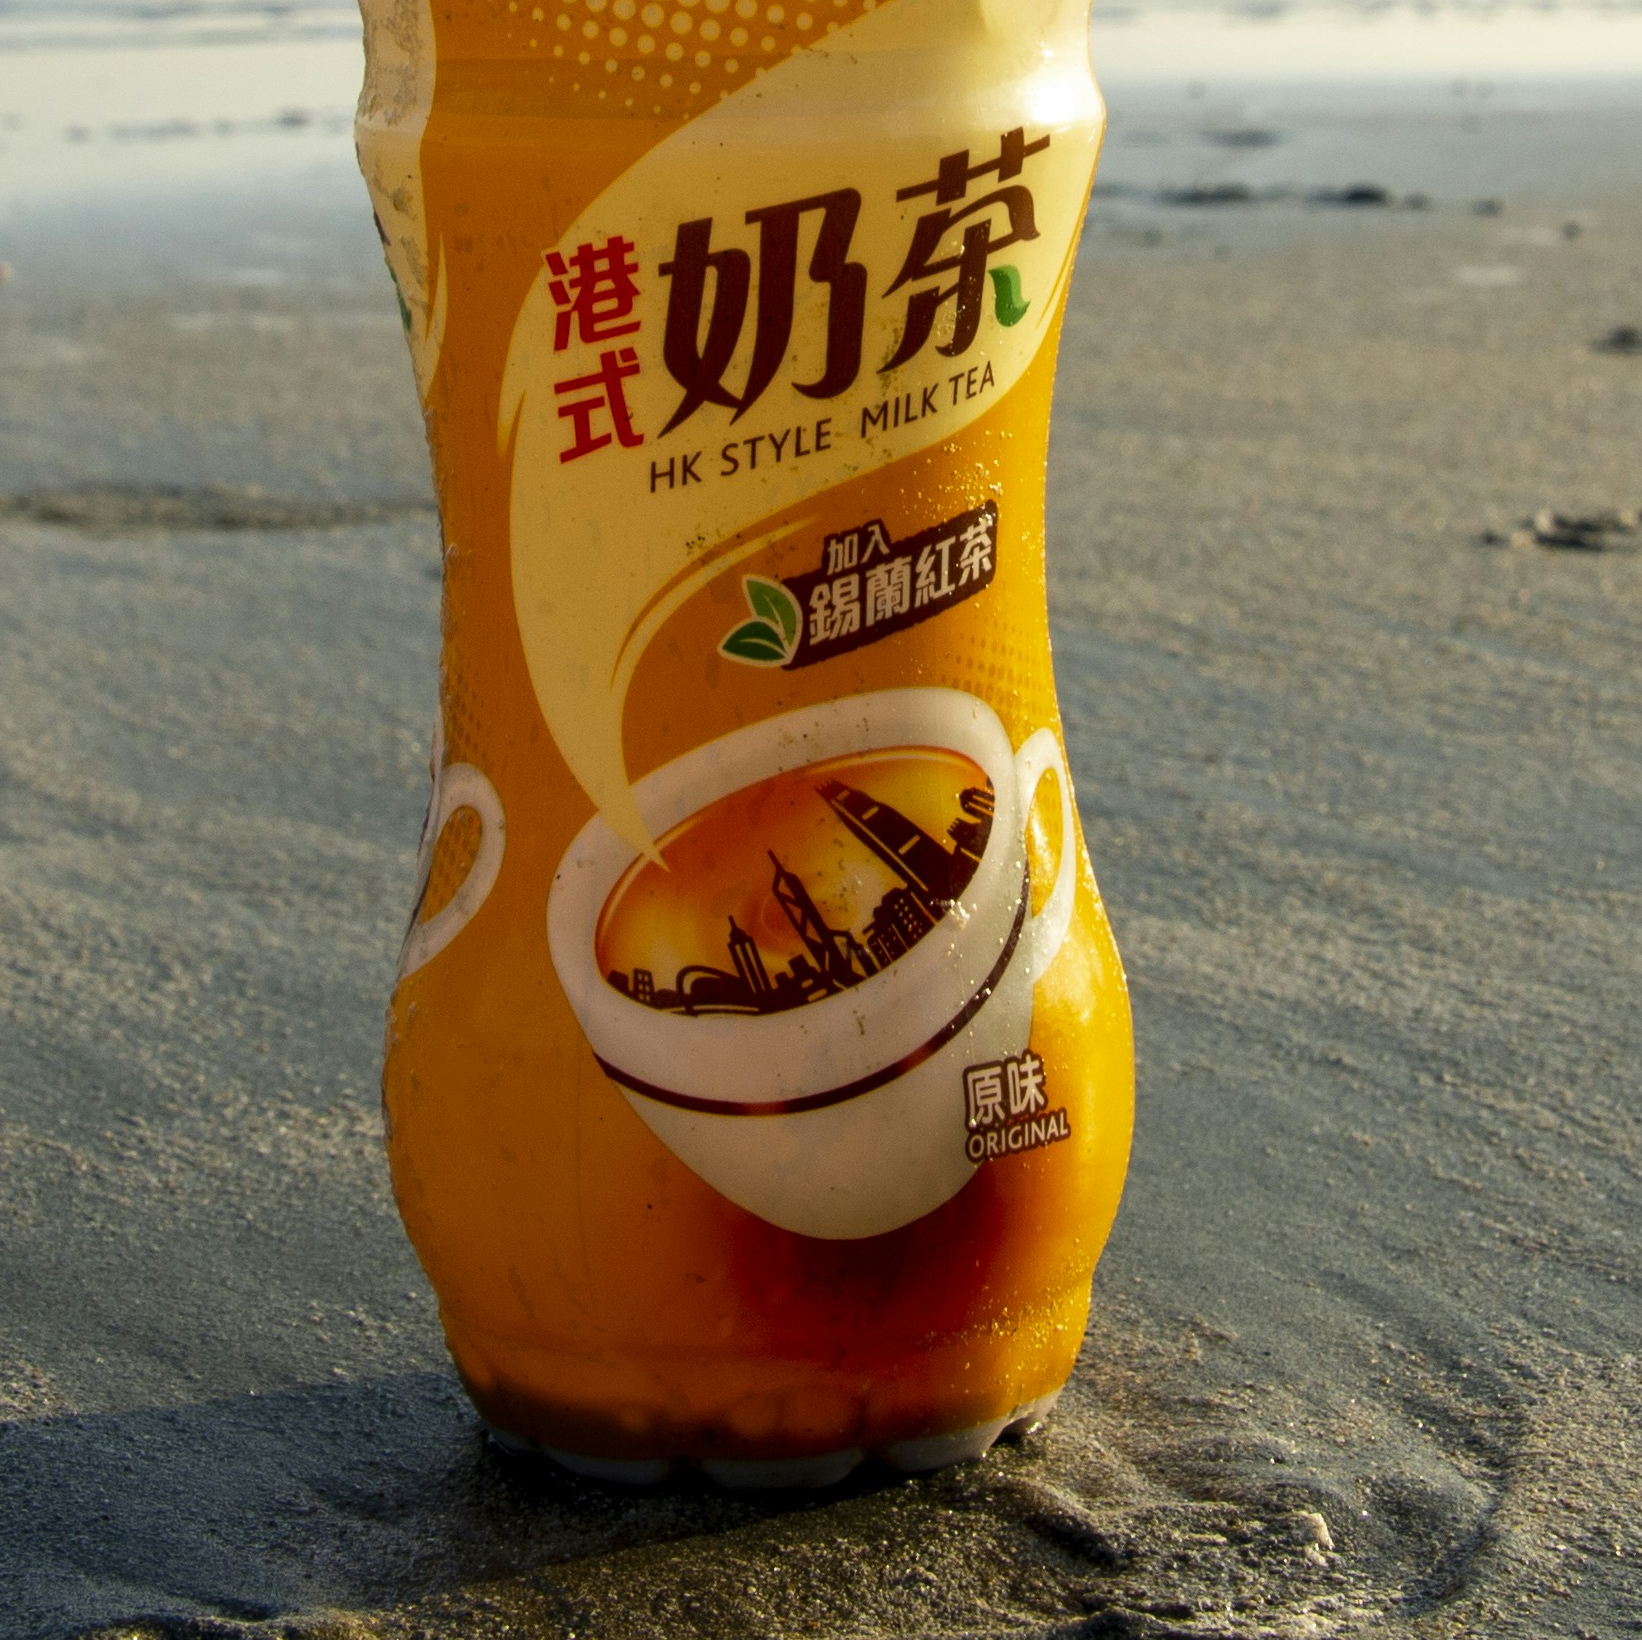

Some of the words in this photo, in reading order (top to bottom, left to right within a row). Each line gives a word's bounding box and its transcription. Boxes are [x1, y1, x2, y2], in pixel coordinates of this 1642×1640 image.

[657, 126, 1050, 439] 奶茶
[545, 235, 644, 464] 港式
[649, 451, 704, 493] HK
[720, 417, 833, 478] STYLE
[860, 381, 939, 439] MILK
[948, 361, 996, 406] TEA
[809, 516, 993, 646] 錫蘭紅茶
[827, 524, 891, 576] 加入
[967, 1054, 1046, 1127] 原味
[968, 1112, 1069, 1158] ORIGINAL
